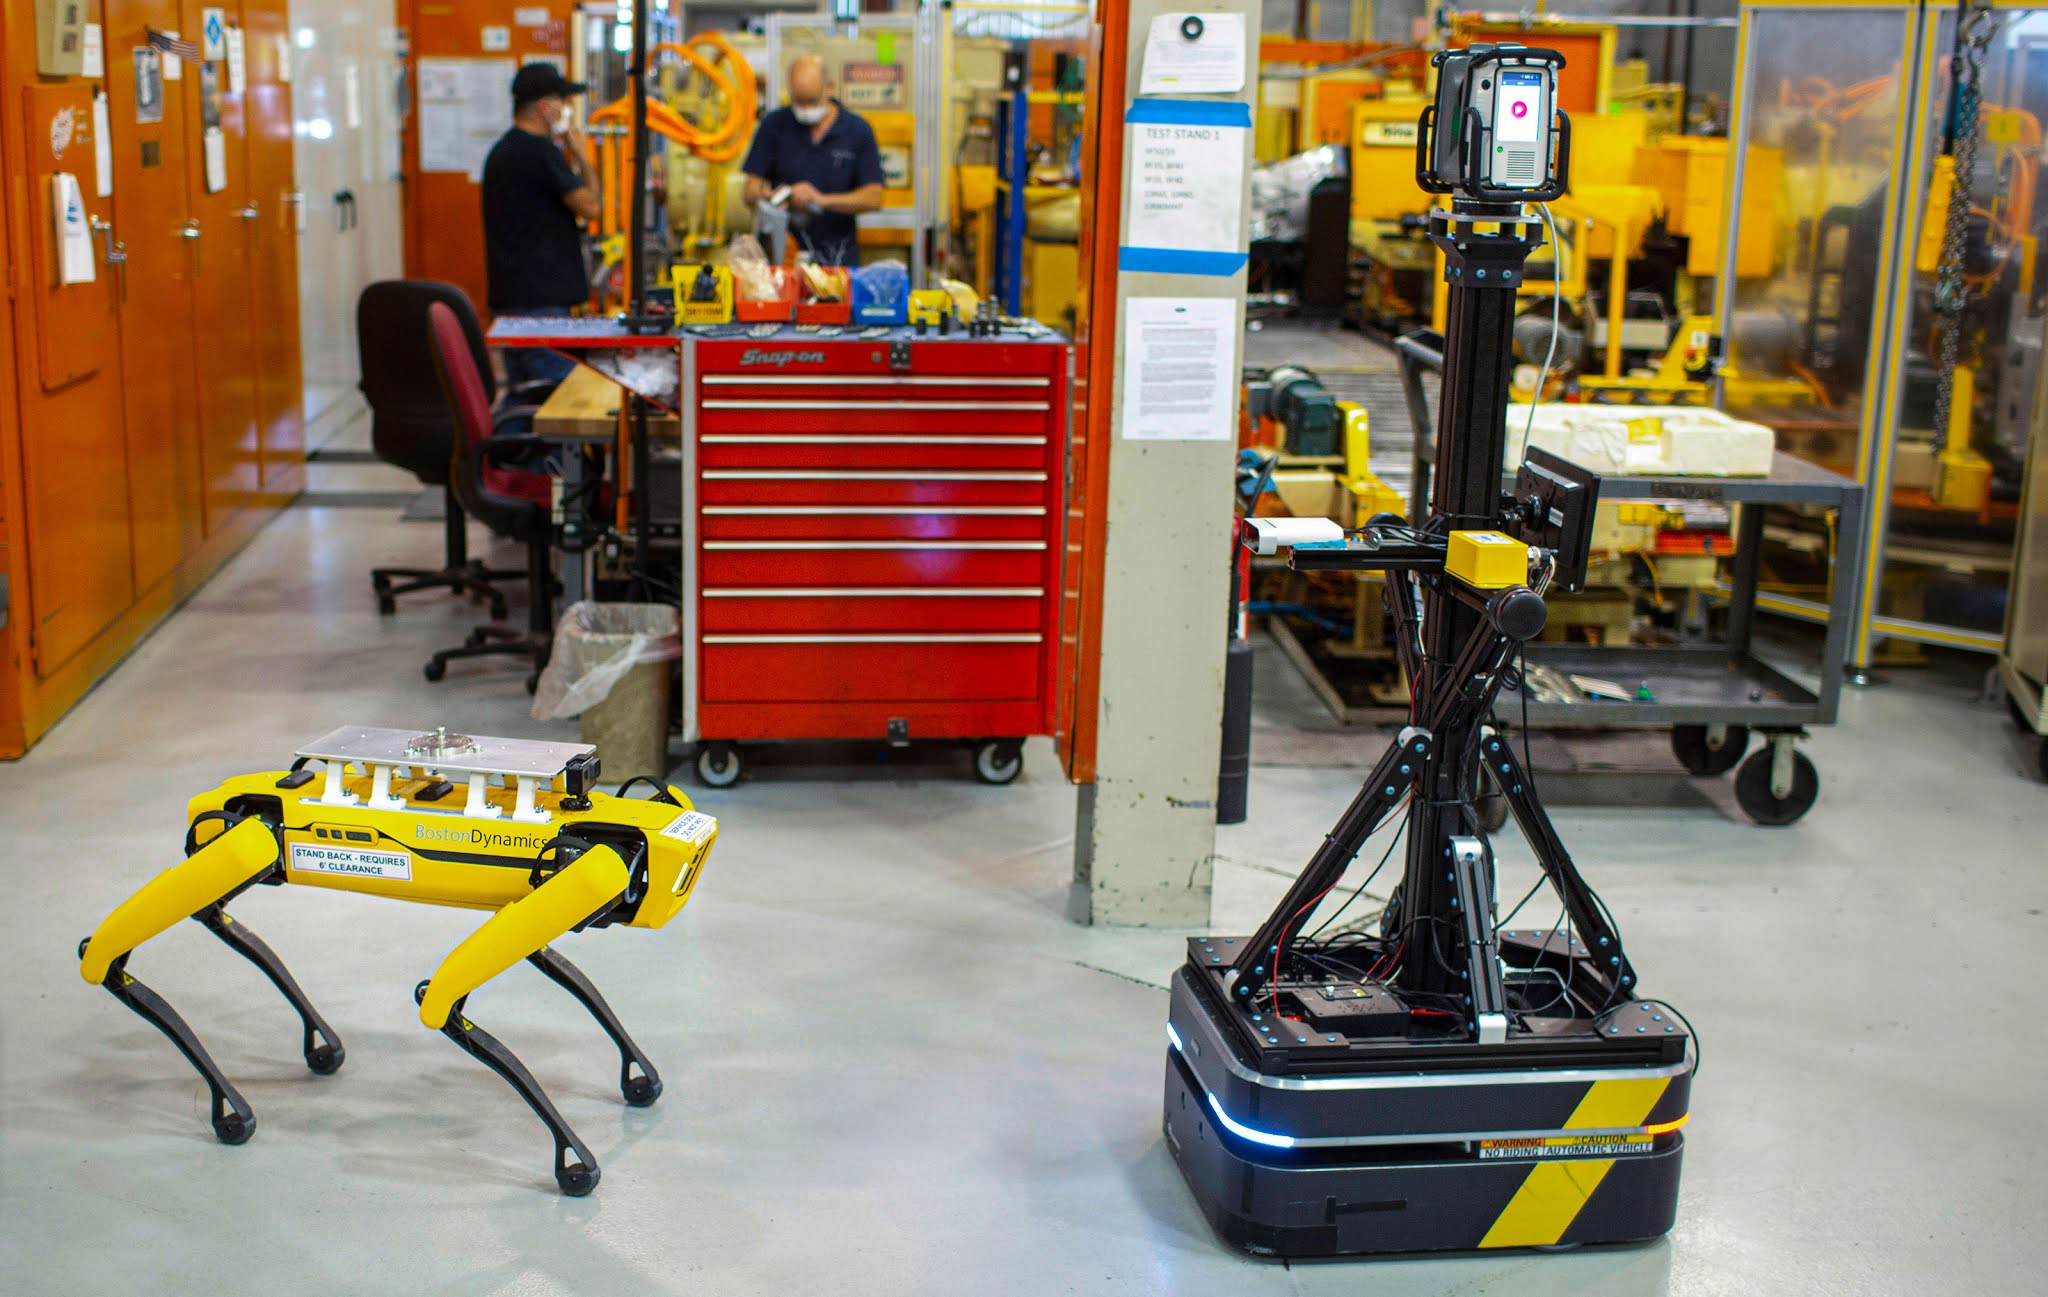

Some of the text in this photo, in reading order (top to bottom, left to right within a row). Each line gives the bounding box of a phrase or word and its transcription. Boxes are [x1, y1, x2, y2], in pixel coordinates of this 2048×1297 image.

[1147, 128, 1171, 139] TEST
[1175, 128, 1211, 140] STAND
[739, 348, 826, 368] Snap-on
[295, 848, 325, 859] STAND
[327, 851, 352, 861] BACK
[360, 854, 405, 867] REQUIRES
[319, 861, 383, 875] 6' CLEARANCE
[1492, 1137, 1542, 1148] WARNING
[1581, 1134, 1628, 1145] CAUTION
[1485, 1147, 1539, 1158] NO RIDING
[1547, 1142, 1652, 1156] AUTOMATIC VEHICLE
